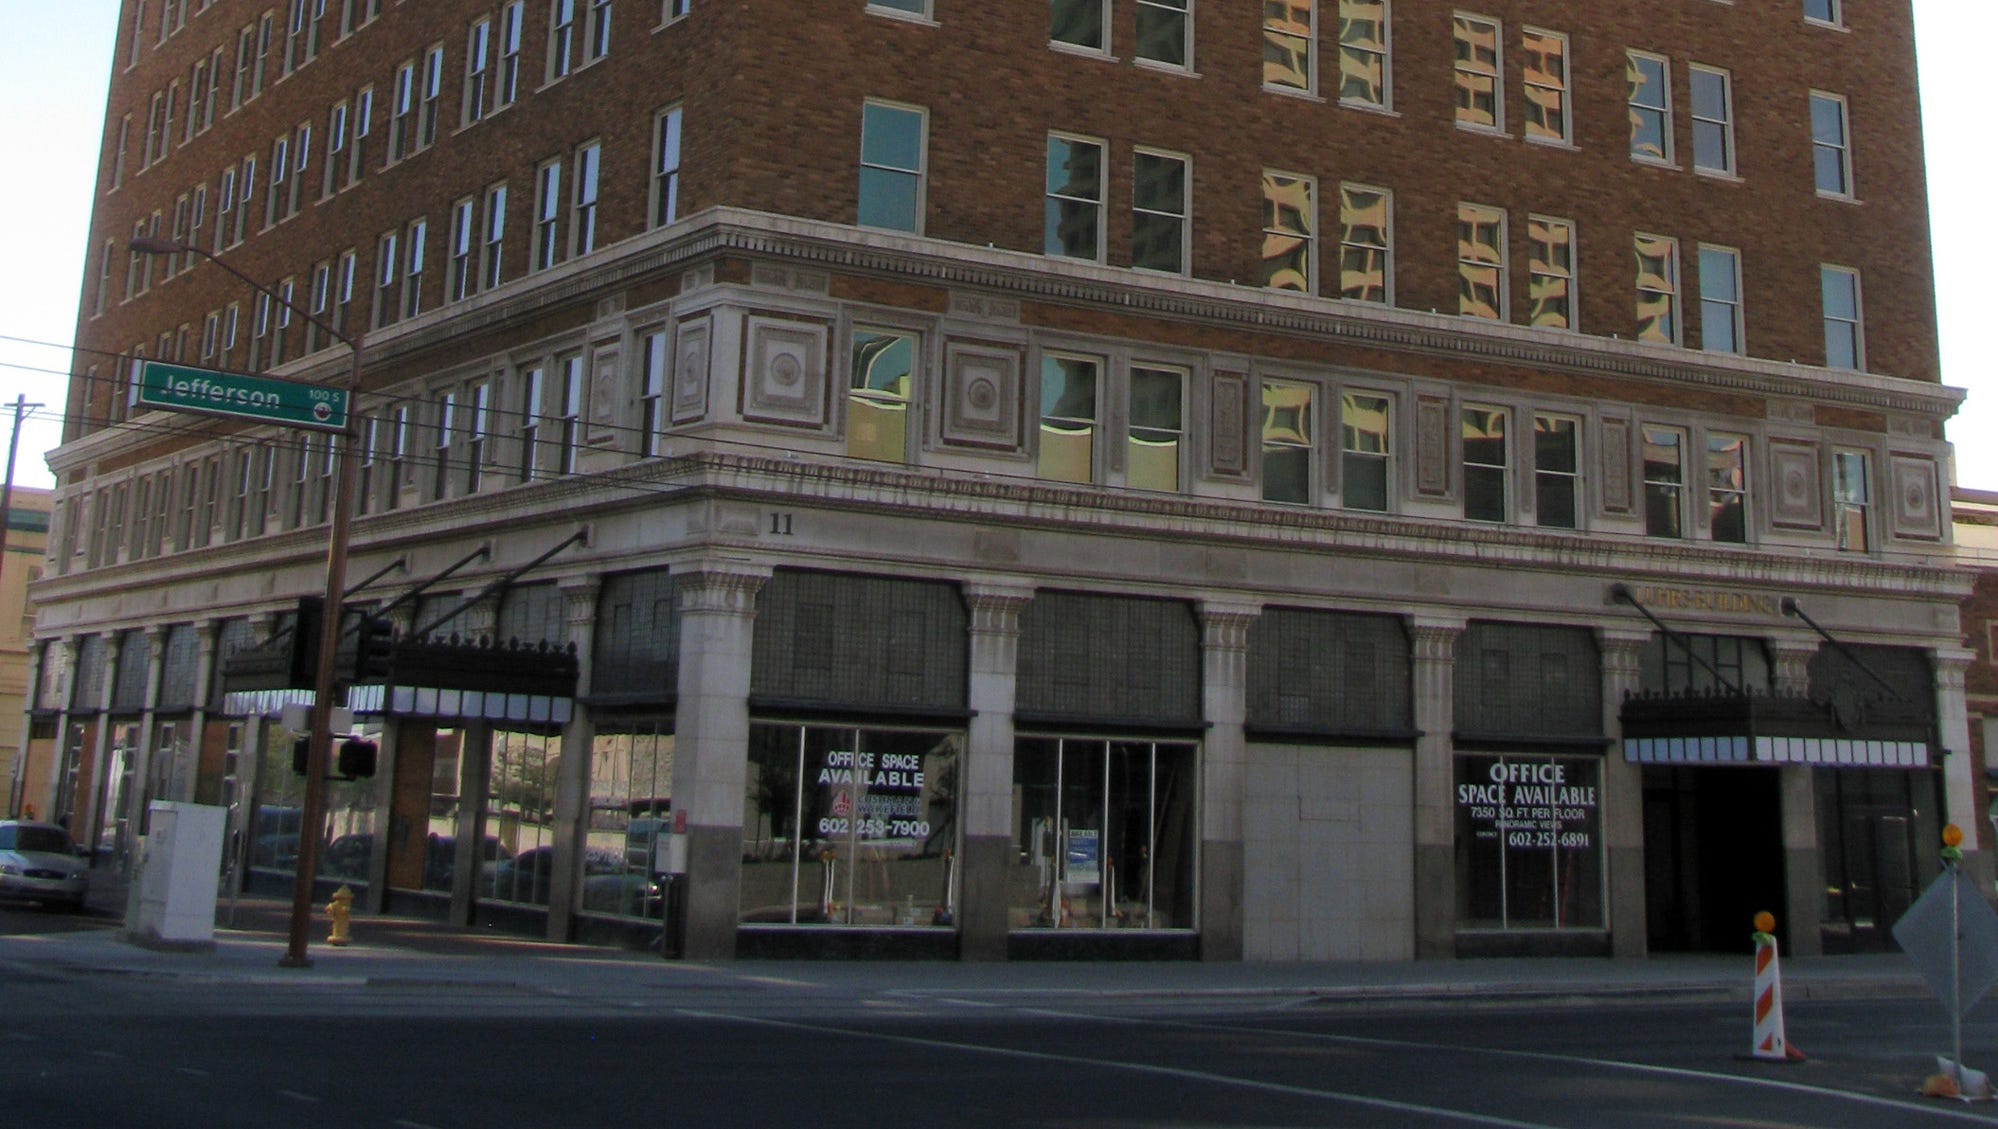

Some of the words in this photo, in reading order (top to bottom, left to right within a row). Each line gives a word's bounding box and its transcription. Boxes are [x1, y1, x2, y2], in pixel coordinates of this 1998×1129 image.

[159, 374, 281, 409] Jefferson
[309, 389, 330, 401] 100
[332, 391, 340, 402] S
[769, 511, 794, 536] 11
[828, 750, 875, 768] OFFICE
[881, 753, 920, 770] SPACE
[818, 768, 924, 788] AVAILABLE
[1489, 762, 1566, 784] OFFICE
[1458, 784, 1506, 804] SPACE
[1513, 785, 1596, 805] AVAILABLE
[1470, 806, 1496, 818] 7350
[1532, 808, 1550, 819] PER
[1554, 808, 1585, 820] FLOOR
[818, 817, 849, 833] 602
[856, 818, 930, 836] 253-7900
